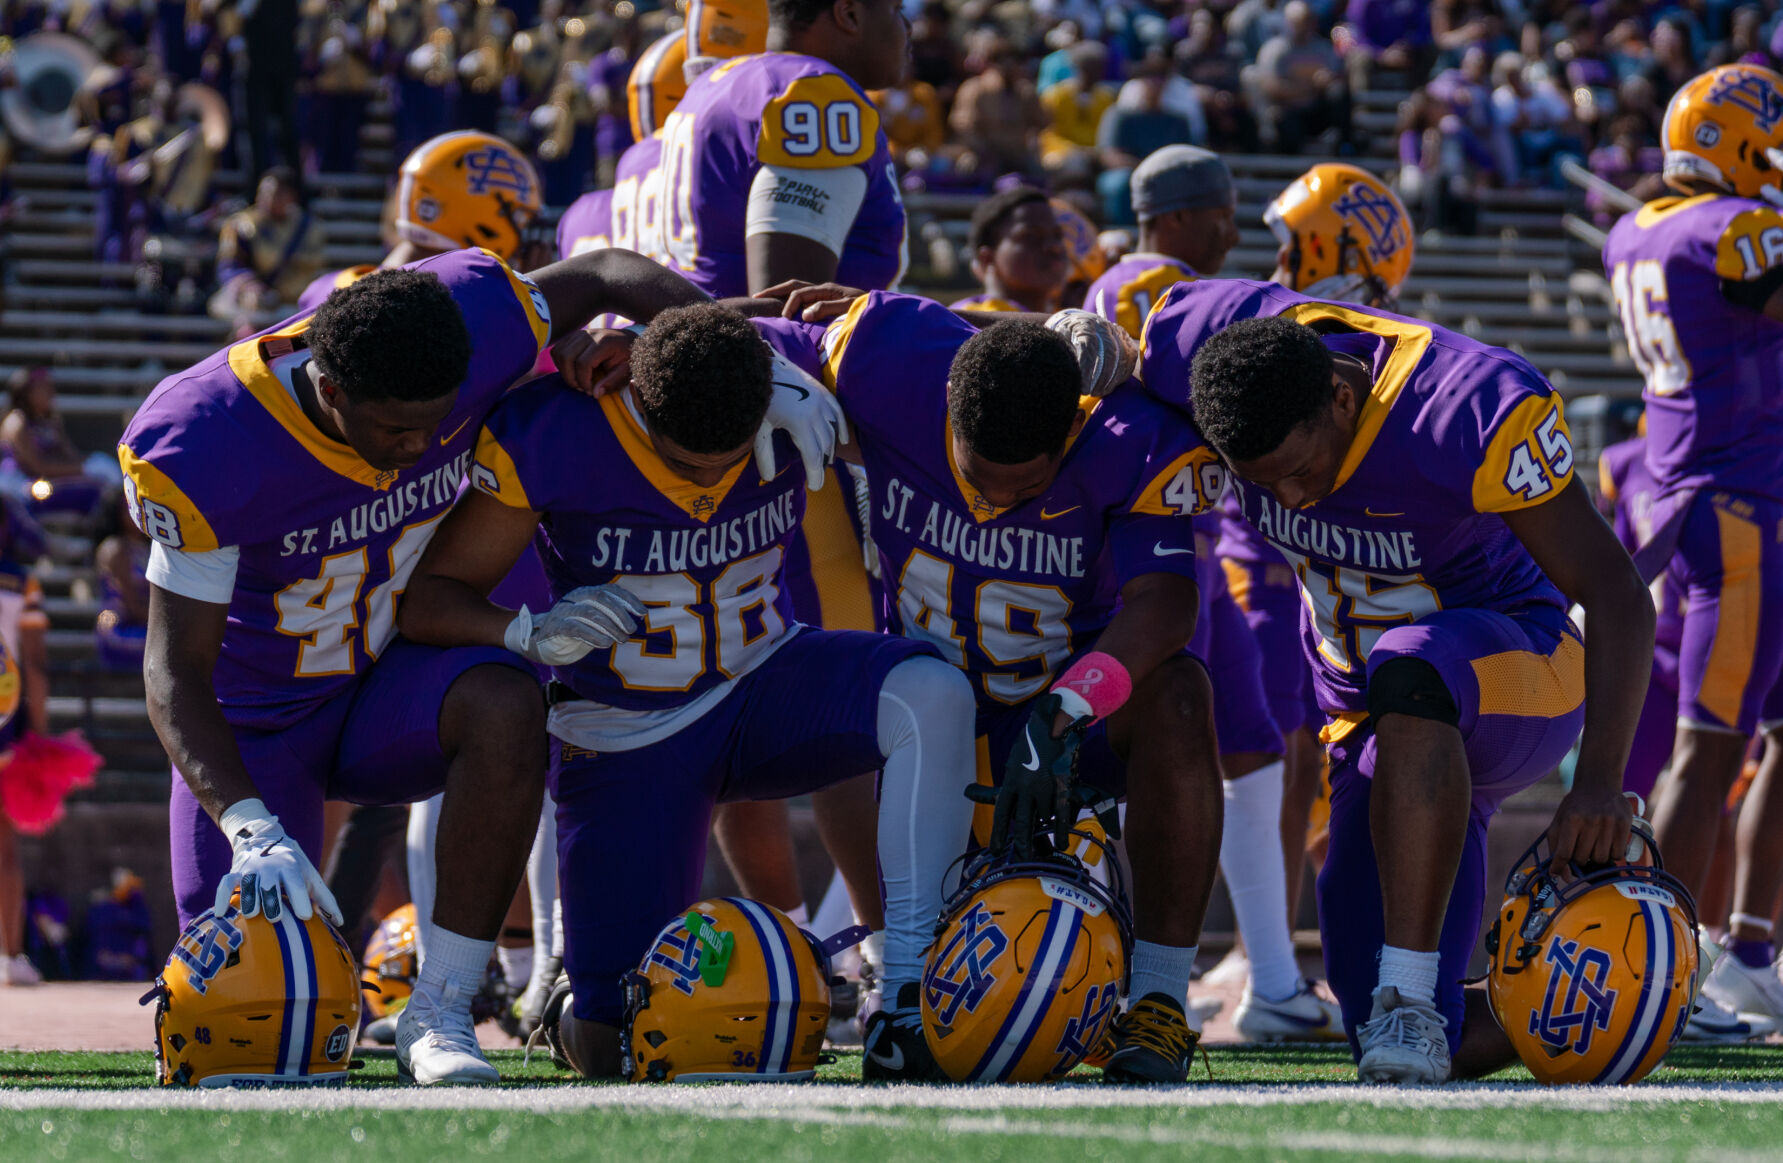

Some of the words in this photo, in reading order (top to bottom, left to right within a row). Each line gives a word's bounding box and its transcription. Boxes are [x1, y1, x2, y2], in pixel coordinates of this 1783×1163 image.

[782, 101, 861, 156] 90
[1503, 404, 1574, 502] 45
[280, 527, 319, 557] ST.
[592, 527, 632, 572] ST.
[644, 488, 797, 573] AUGUSTINE
[882, 478, 915, 533] ST.
[919, 501, 1086, 578] AUGUSTINE
[1258, 495, 1422, 570] AUGUSTINE
[896, 547, 1075, 706] 49
[195, 1026, 211, 1045] 48
[327, 1033, 348, 1054] ED
[732, 1049, 756, 1068] 36
